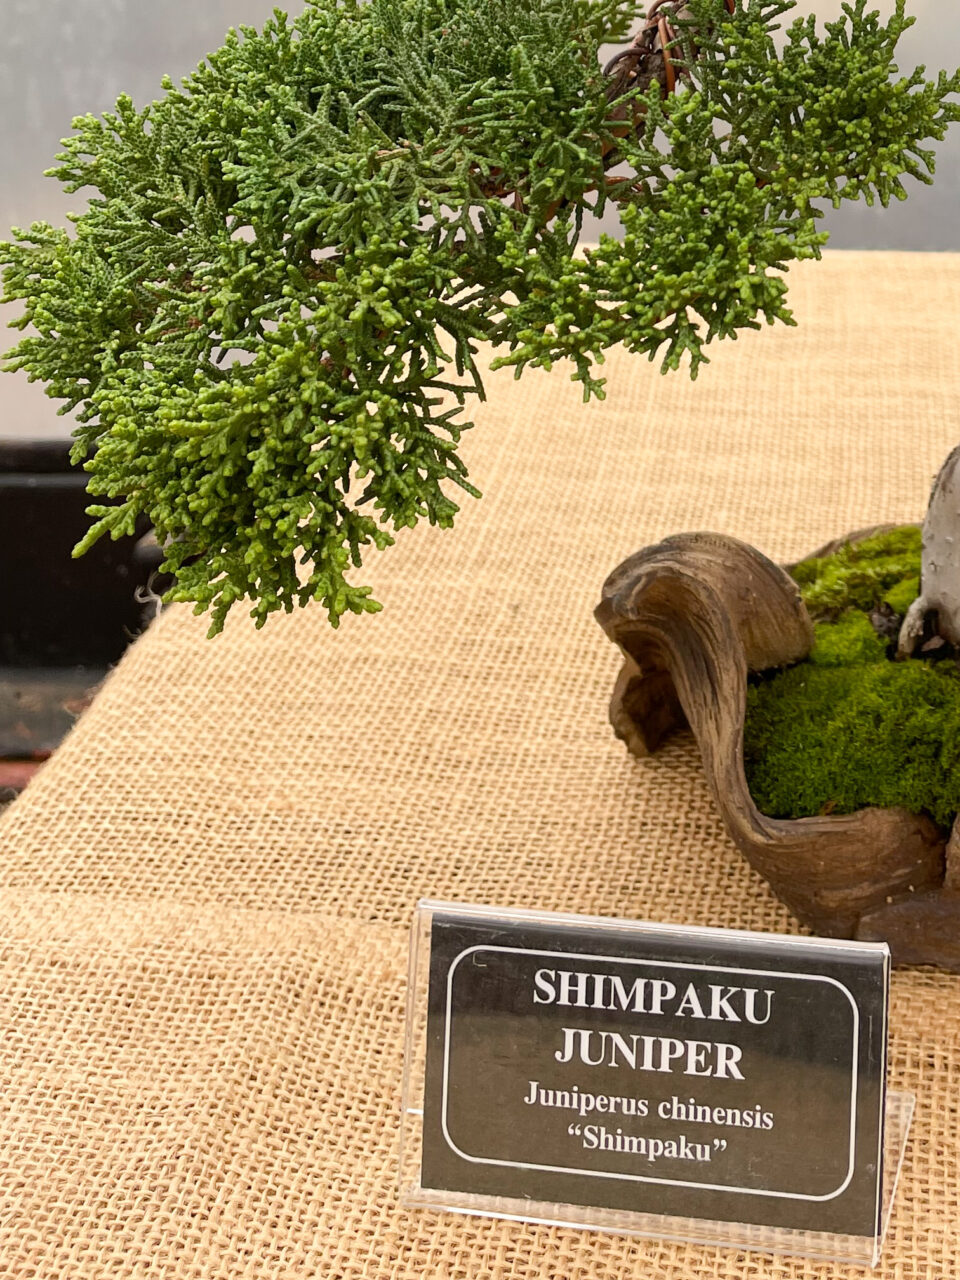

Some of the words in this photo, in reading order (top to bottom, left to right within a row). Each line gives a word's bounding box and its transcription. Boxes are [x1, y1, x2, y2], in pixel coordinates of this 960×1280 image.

[533, 968, 775, 1025] SHIMPAKU
[555, 1027, 745, 1081] JUNIPER
[524, 1081, 649, 1119] Juniperus
[657, 1096, 774, 1130] chinensis
[568, 1124, 727, 1163] “Shimpaku”
